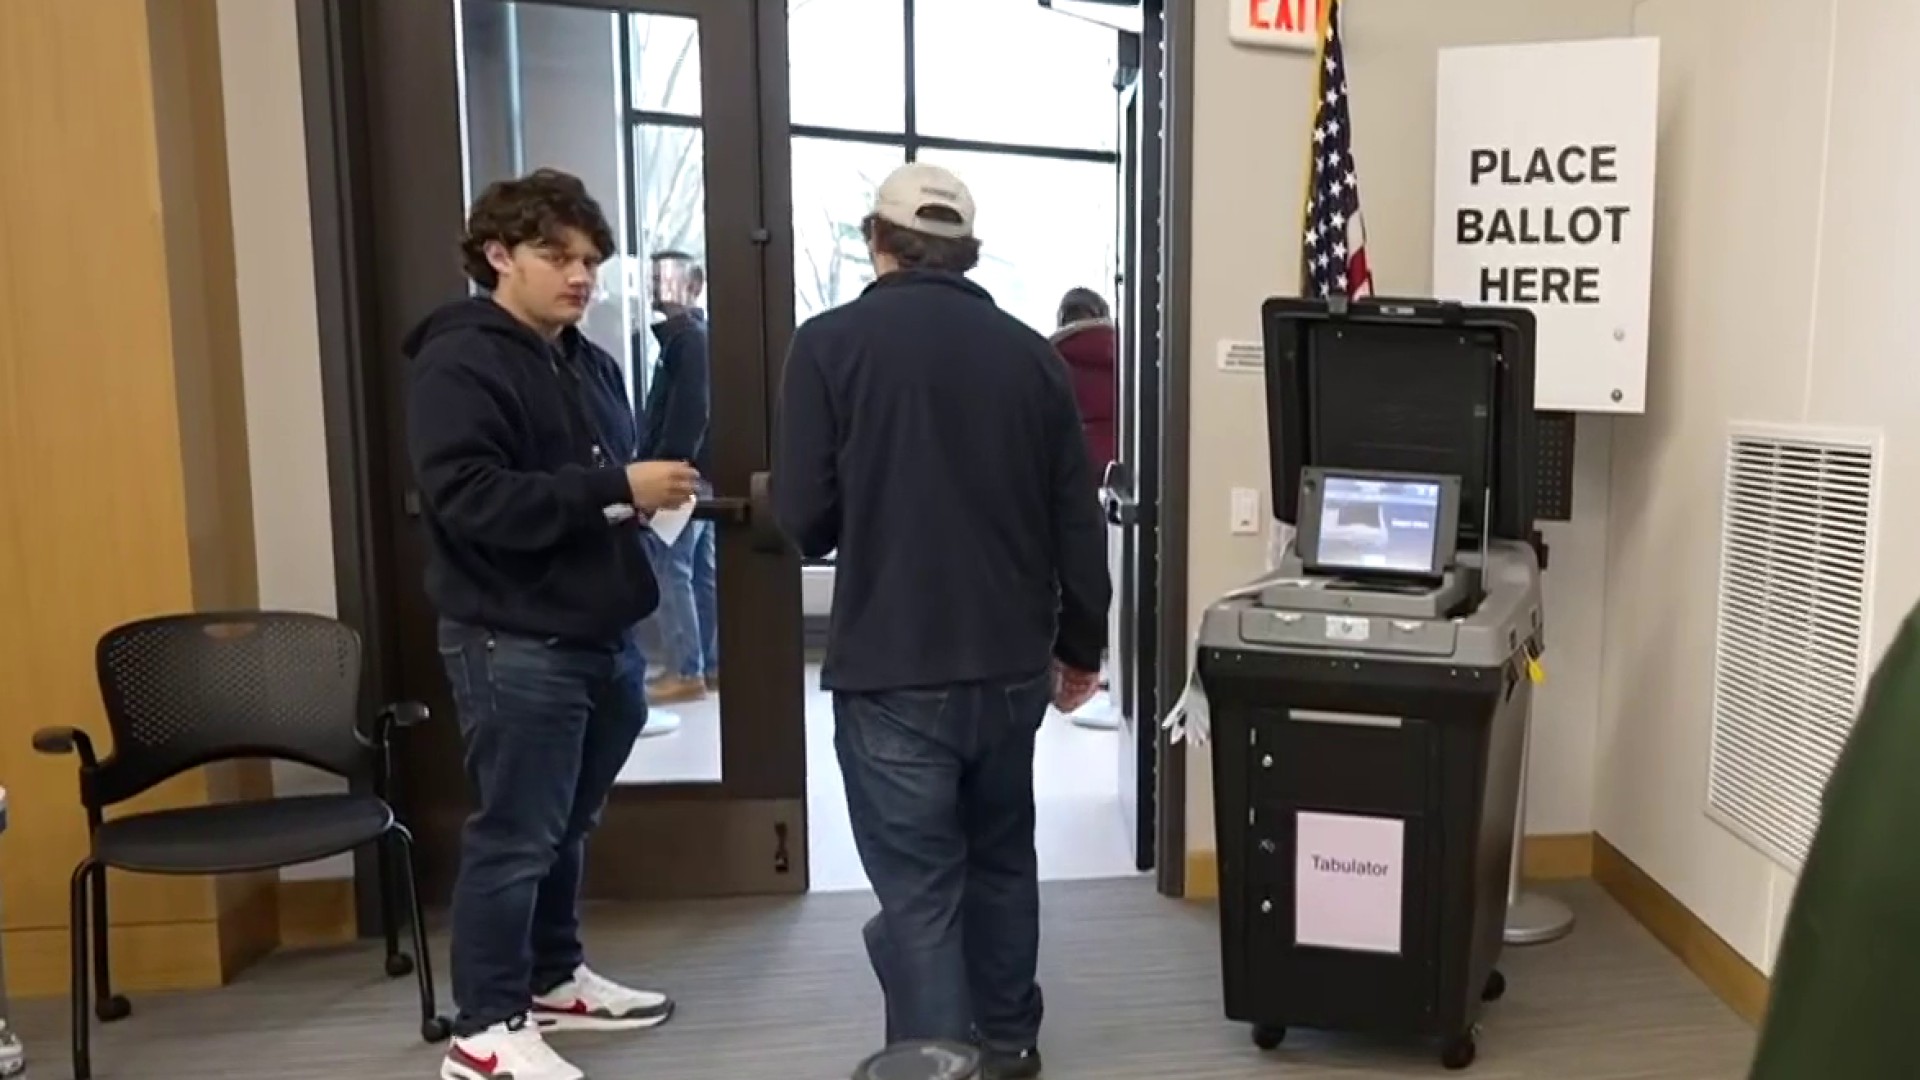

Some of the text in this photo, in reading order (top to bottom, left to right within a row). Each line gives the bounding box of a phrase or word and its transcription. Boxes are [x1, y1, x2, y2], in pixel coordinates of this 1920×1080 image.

[1470, 146, 1617, 185] PLACE
[1456, 206, 1630, 244] BALLOT
[1480, 267, 1599, 303] HERE
[1312, 855, 1389, 876] Tabulator
